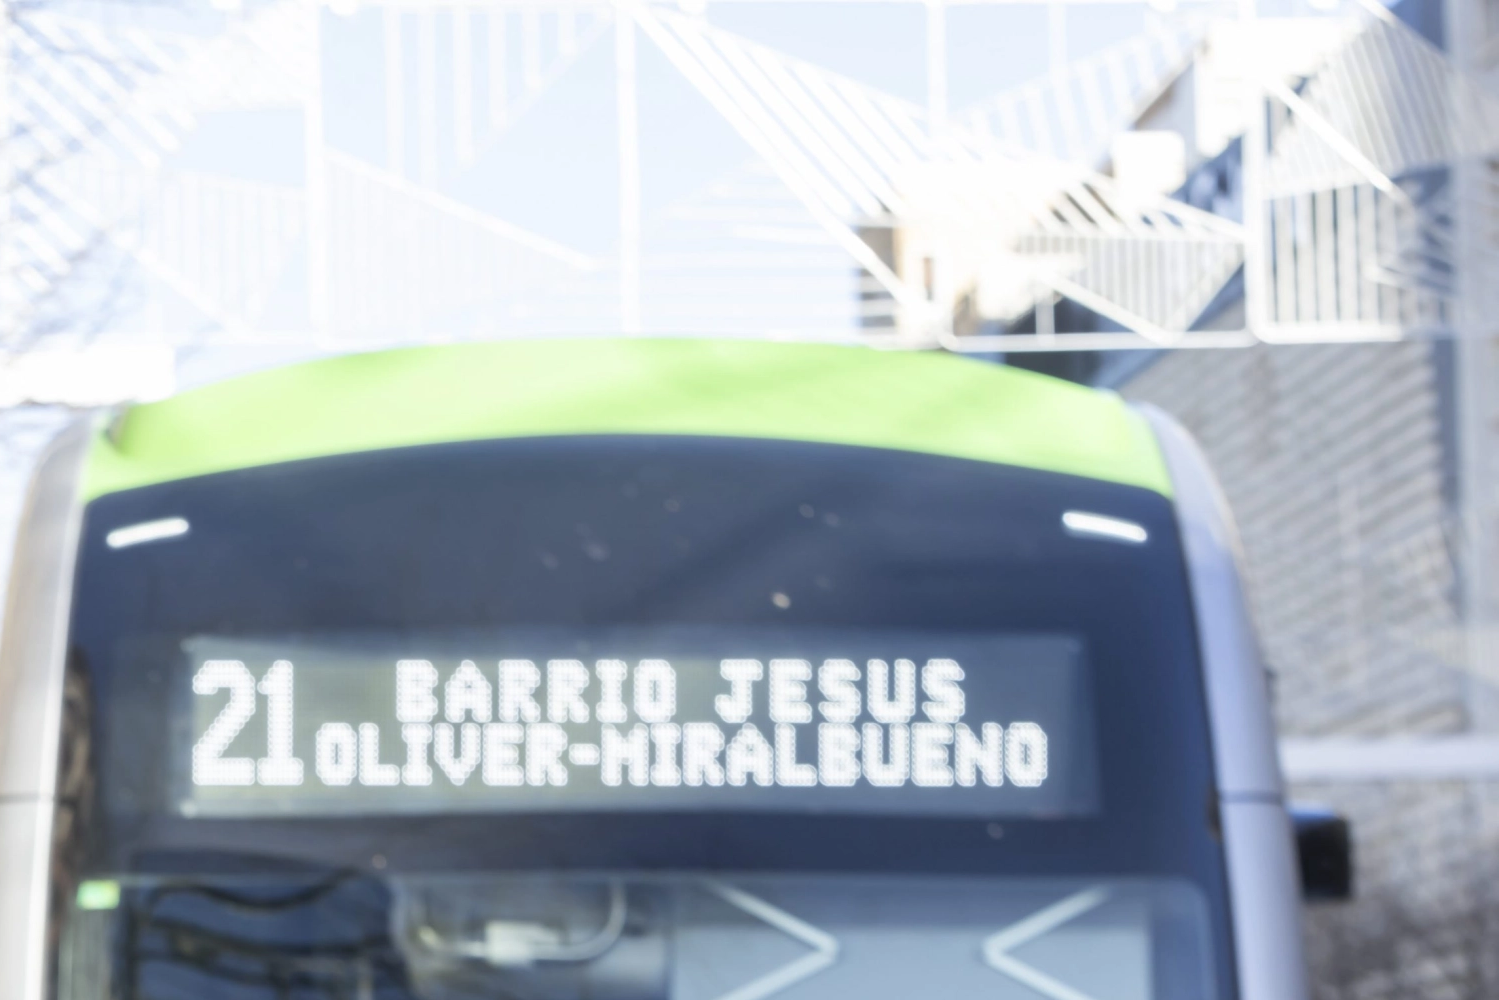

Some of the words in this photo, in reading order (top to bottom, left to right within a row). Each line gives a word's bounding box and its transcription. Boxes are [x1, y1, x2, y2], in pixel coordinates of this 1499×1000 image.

[193, 660, 303, 786] 21
[396, 660, 677, 722] BARRIO
[715, 660, 965, 722] JESUS
[315, 722, 1049, 786] OLIVER-MIRALBUENO
